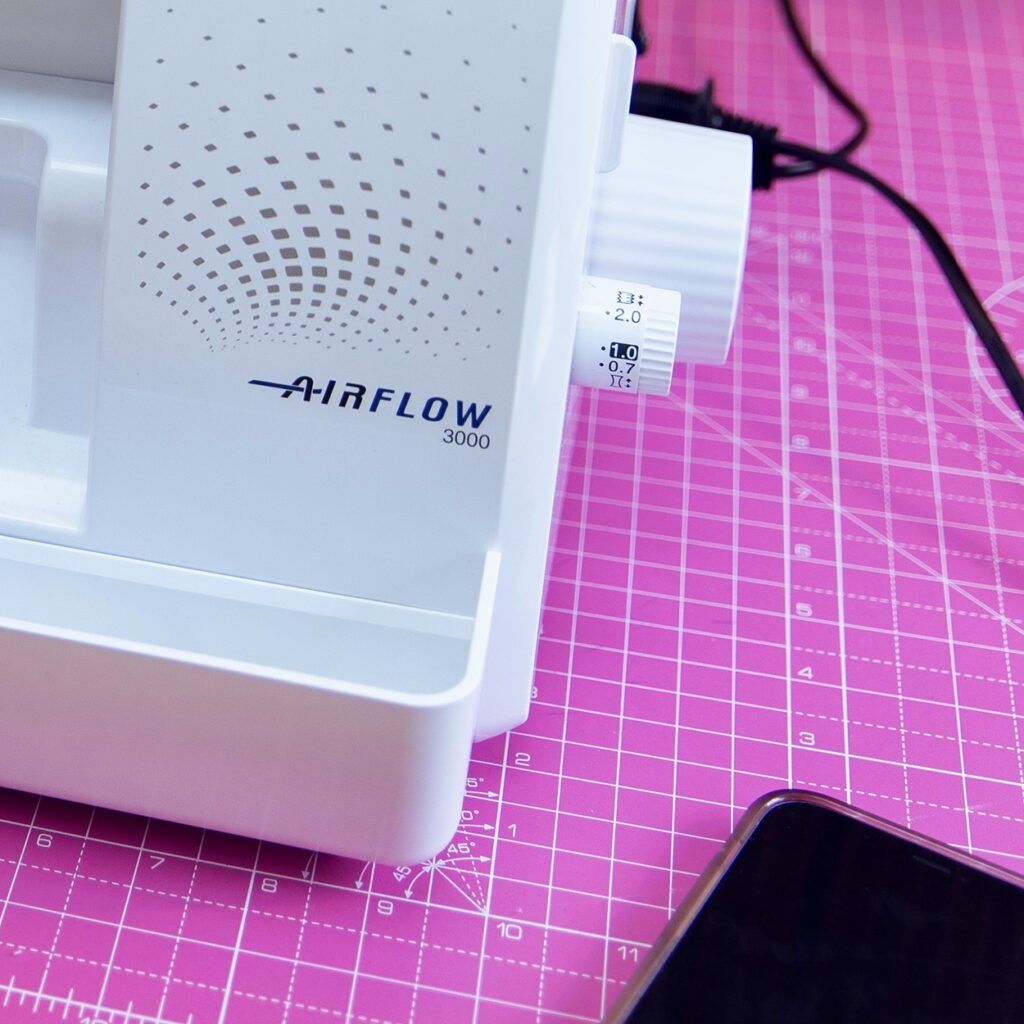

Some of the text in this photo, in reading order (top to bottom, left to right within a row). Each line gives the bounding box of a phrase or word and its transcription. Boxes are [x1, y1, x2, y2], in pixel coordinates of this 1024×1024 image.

[614, 308, 642, 324] 2.0
[611, 343, 638, 359] 1.0
[608, 360, 636, 374] 0.7
[248, 375, 492, 429] AIRFLOW
[442, 428, 491, 450] 3000
[795, 602, 813, 617] 5
[797, 666, 814, 680] 4
[799, 732, 816, 746] 3
[514, 752, 531, 767] 2
[507, 823, 517, 838] 1
[36, 833, 53, 849] 6
[149, 855, 165, 871] 7
[261, 878, 278, 894] 8
[377, 900, 394, 916] 9
[496, 922, 522, 940] 10
[617, 945, 640, 963] 11
